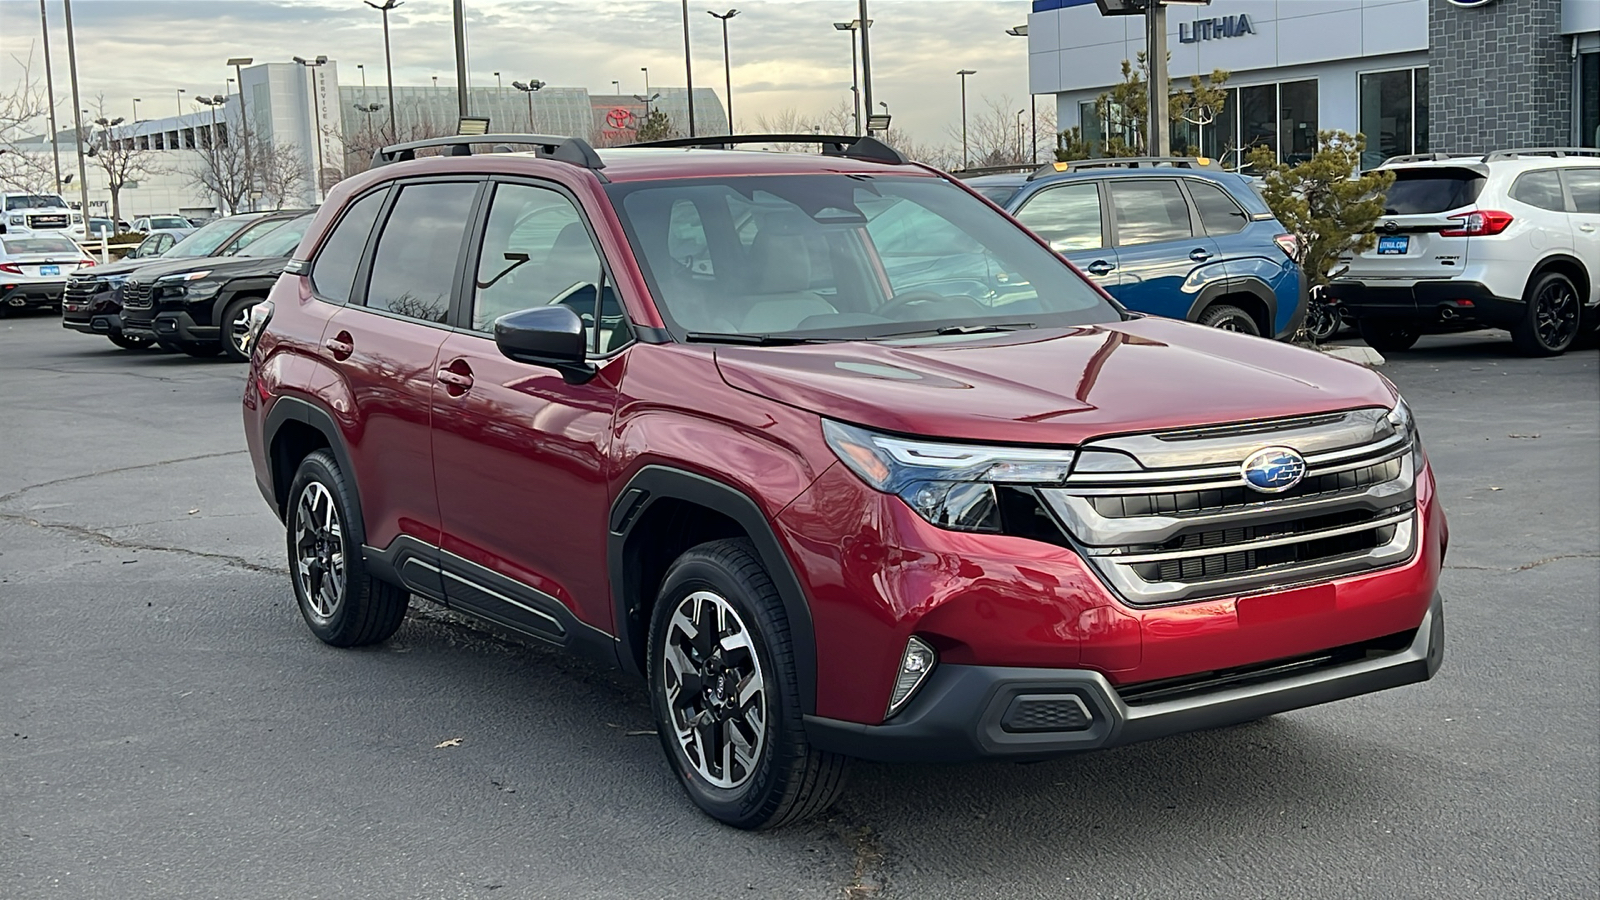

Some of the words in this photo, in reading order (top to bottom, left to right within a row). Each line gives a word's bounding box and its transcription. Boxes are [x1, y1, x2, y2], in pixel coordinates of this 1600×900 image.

[1179, 13, 1256, 43] LITHIA
[320, 73, 328, 119] SERVICE
[323, 124, 331, 164] CENTER
